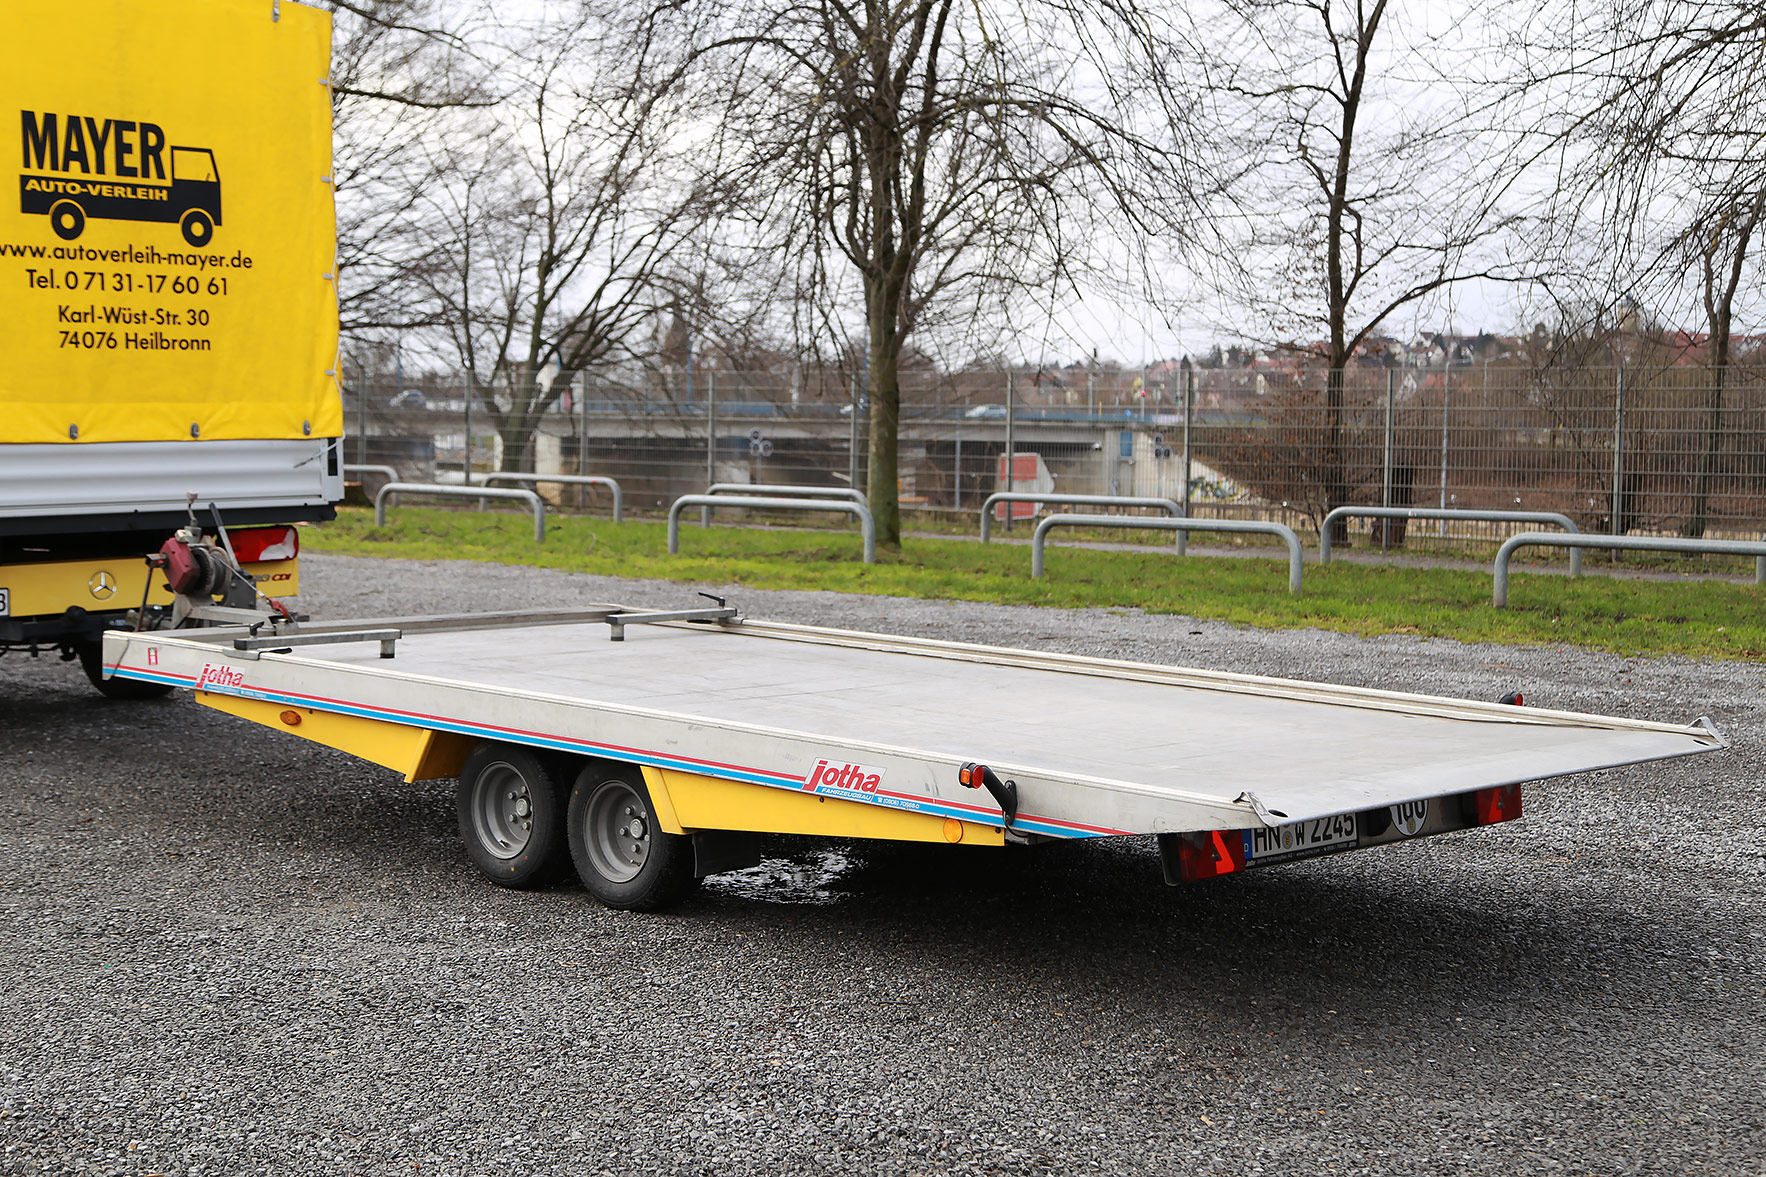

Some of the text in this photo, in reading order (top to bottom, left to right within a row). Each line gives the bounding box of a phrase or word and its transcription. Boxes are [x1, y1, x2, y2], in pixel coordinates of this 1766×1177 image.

[21, 110, 166, 179] MAYER
[25, 179, 168, 201] AUTO-VERLEIH
[26, 269, 60, 288] Tel.
[66, 271, 78, 289] 0
[84, 272, 104, 290] 71
[208, 278, 226, 295] 61
[187, 309, 209, 325] 30
[60, 331, 210, 350] 74076 Heilbronn
[195, 664, 245, 688] jotha
[802, 760, 881, 793] jotha
[821, 787, 873, 801] FAHRZEUGBAU
[1254, 826, 1281, 853] HN
[1295, 821, 1305, 846] W
[1311, 813, 1354, 843] 2245
